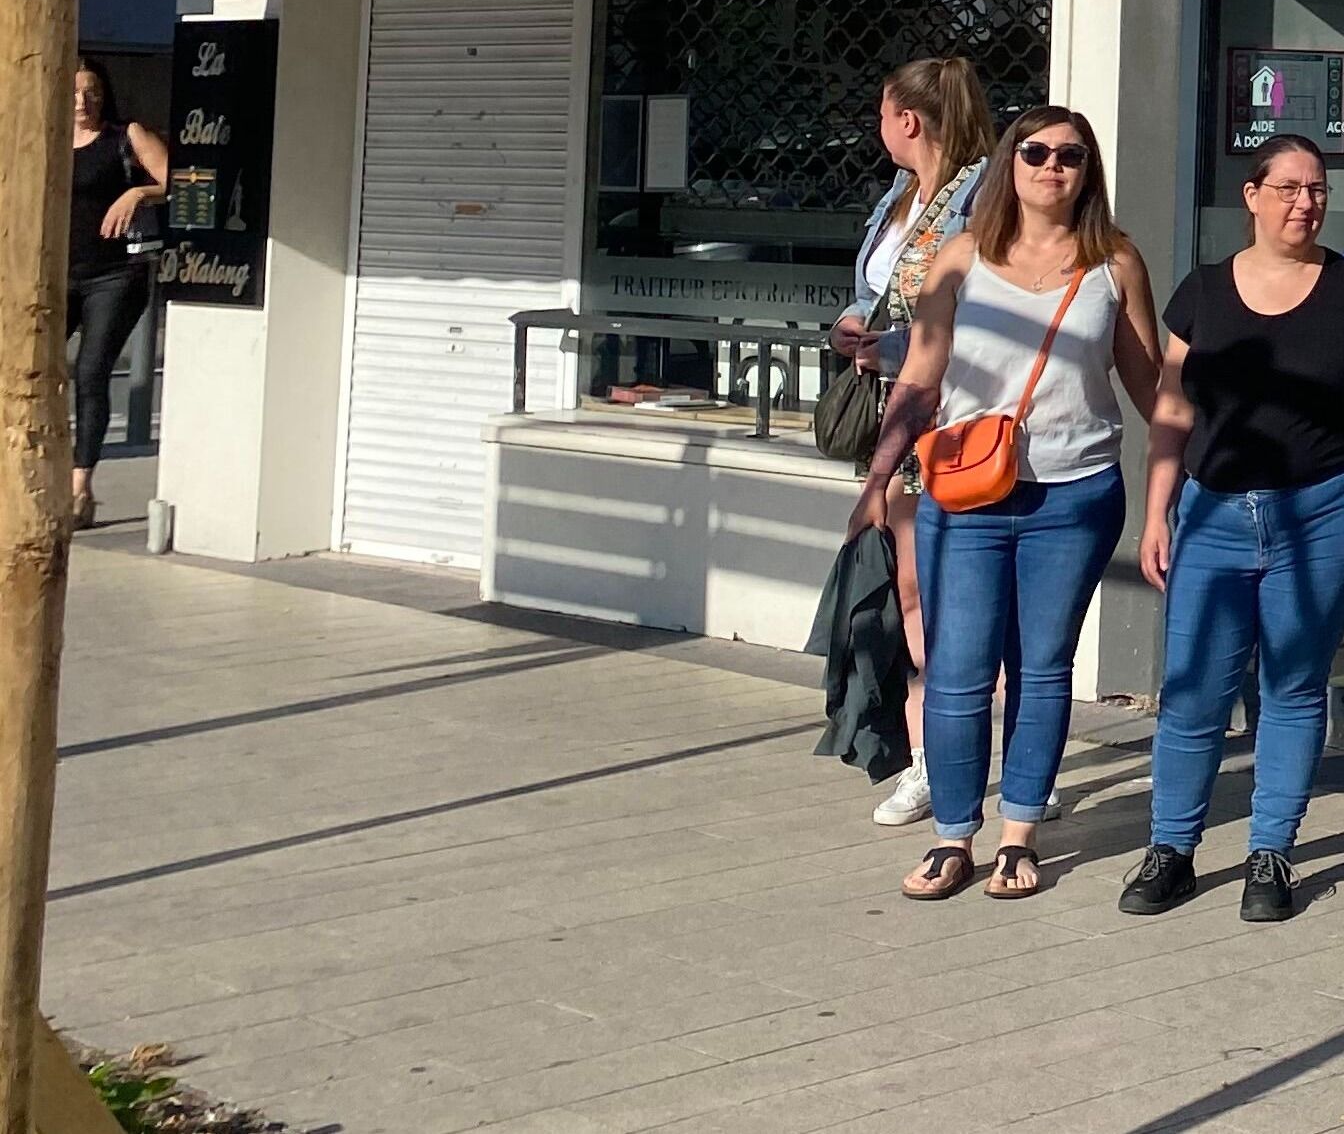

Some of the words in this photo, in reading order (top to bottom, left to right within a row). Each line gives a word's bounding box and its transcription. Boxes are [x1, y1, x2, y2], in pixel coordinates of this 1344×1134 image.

[192, 41, 227, 77] La
[1250, 121, 1275, 133] AIDE
[1233, 131, 1243, 147] À
[610, 274, 706, 300] TRAITEUR
